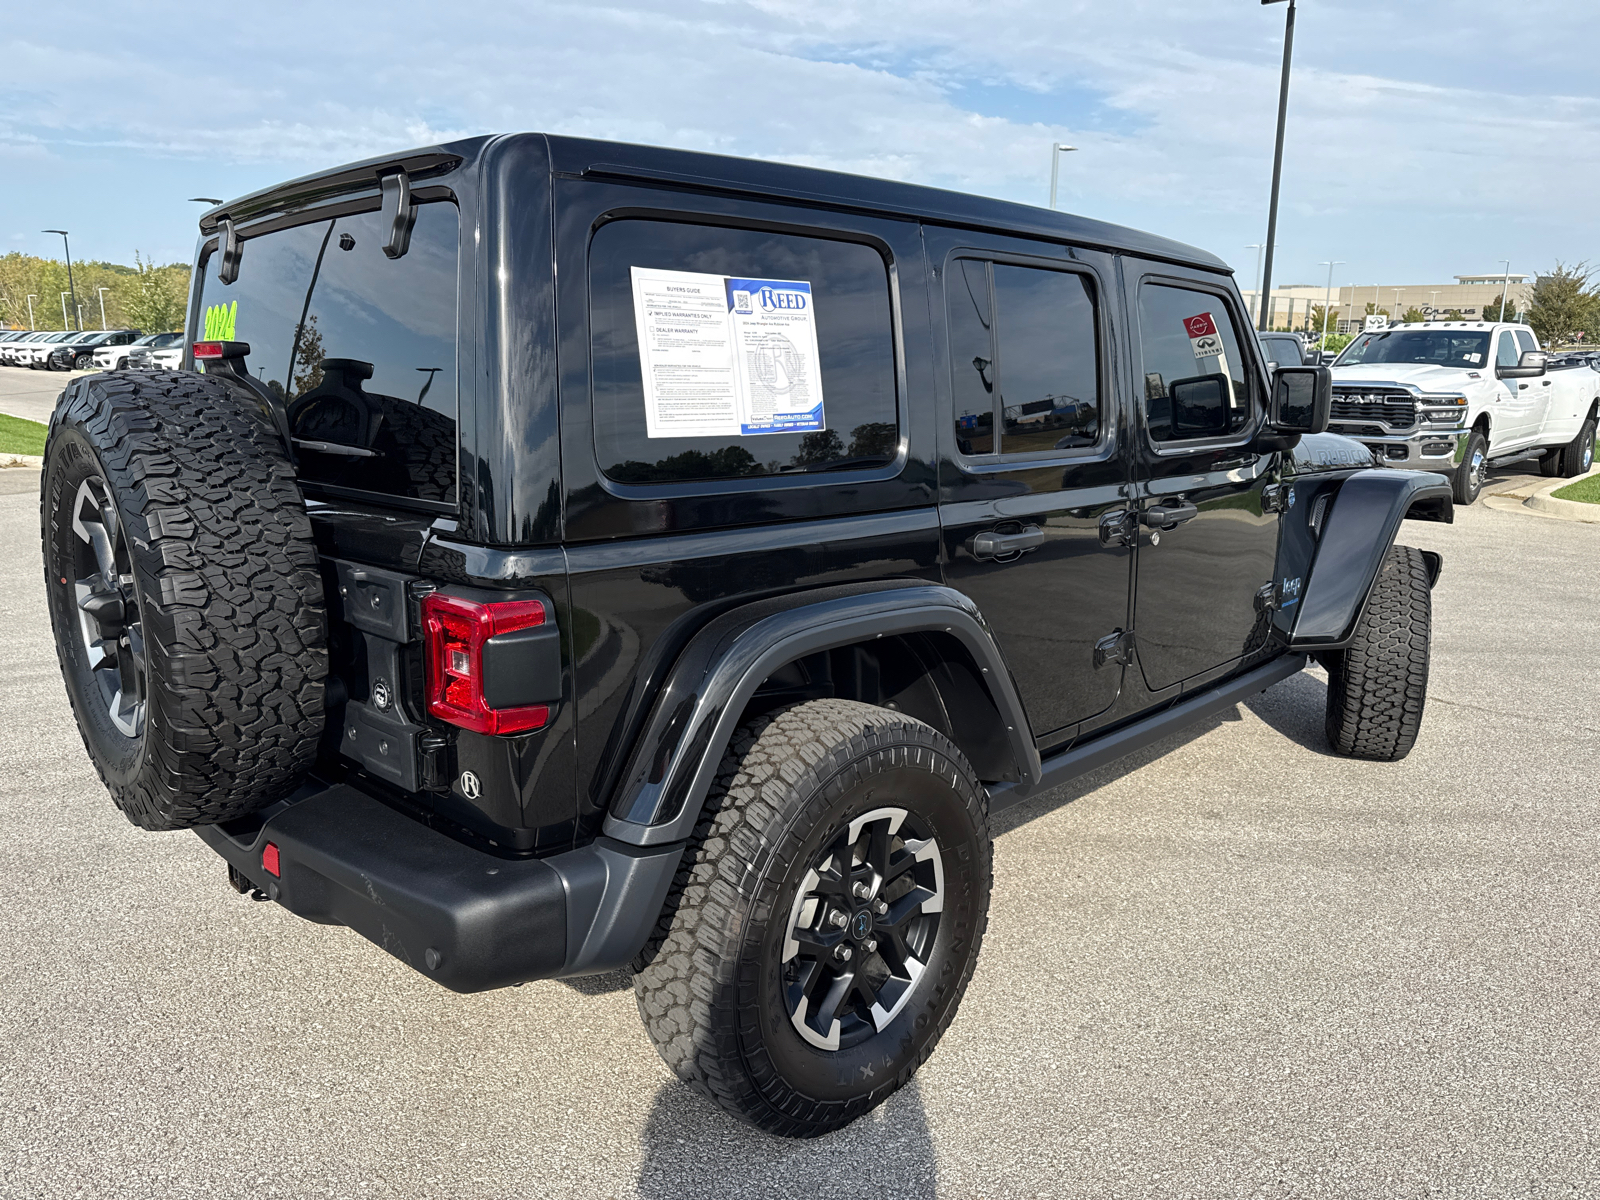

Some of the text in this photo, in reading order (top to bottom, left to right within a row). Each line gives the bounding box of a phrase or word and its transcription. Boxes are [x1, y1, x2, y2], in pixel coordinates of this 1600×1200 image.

[761, 289, 806, 310] REED
[203, 299, 238, 342] 2024
[1331, 394, 1383, 404] RAM
[1283, 577, 1301, 596] Jeep
